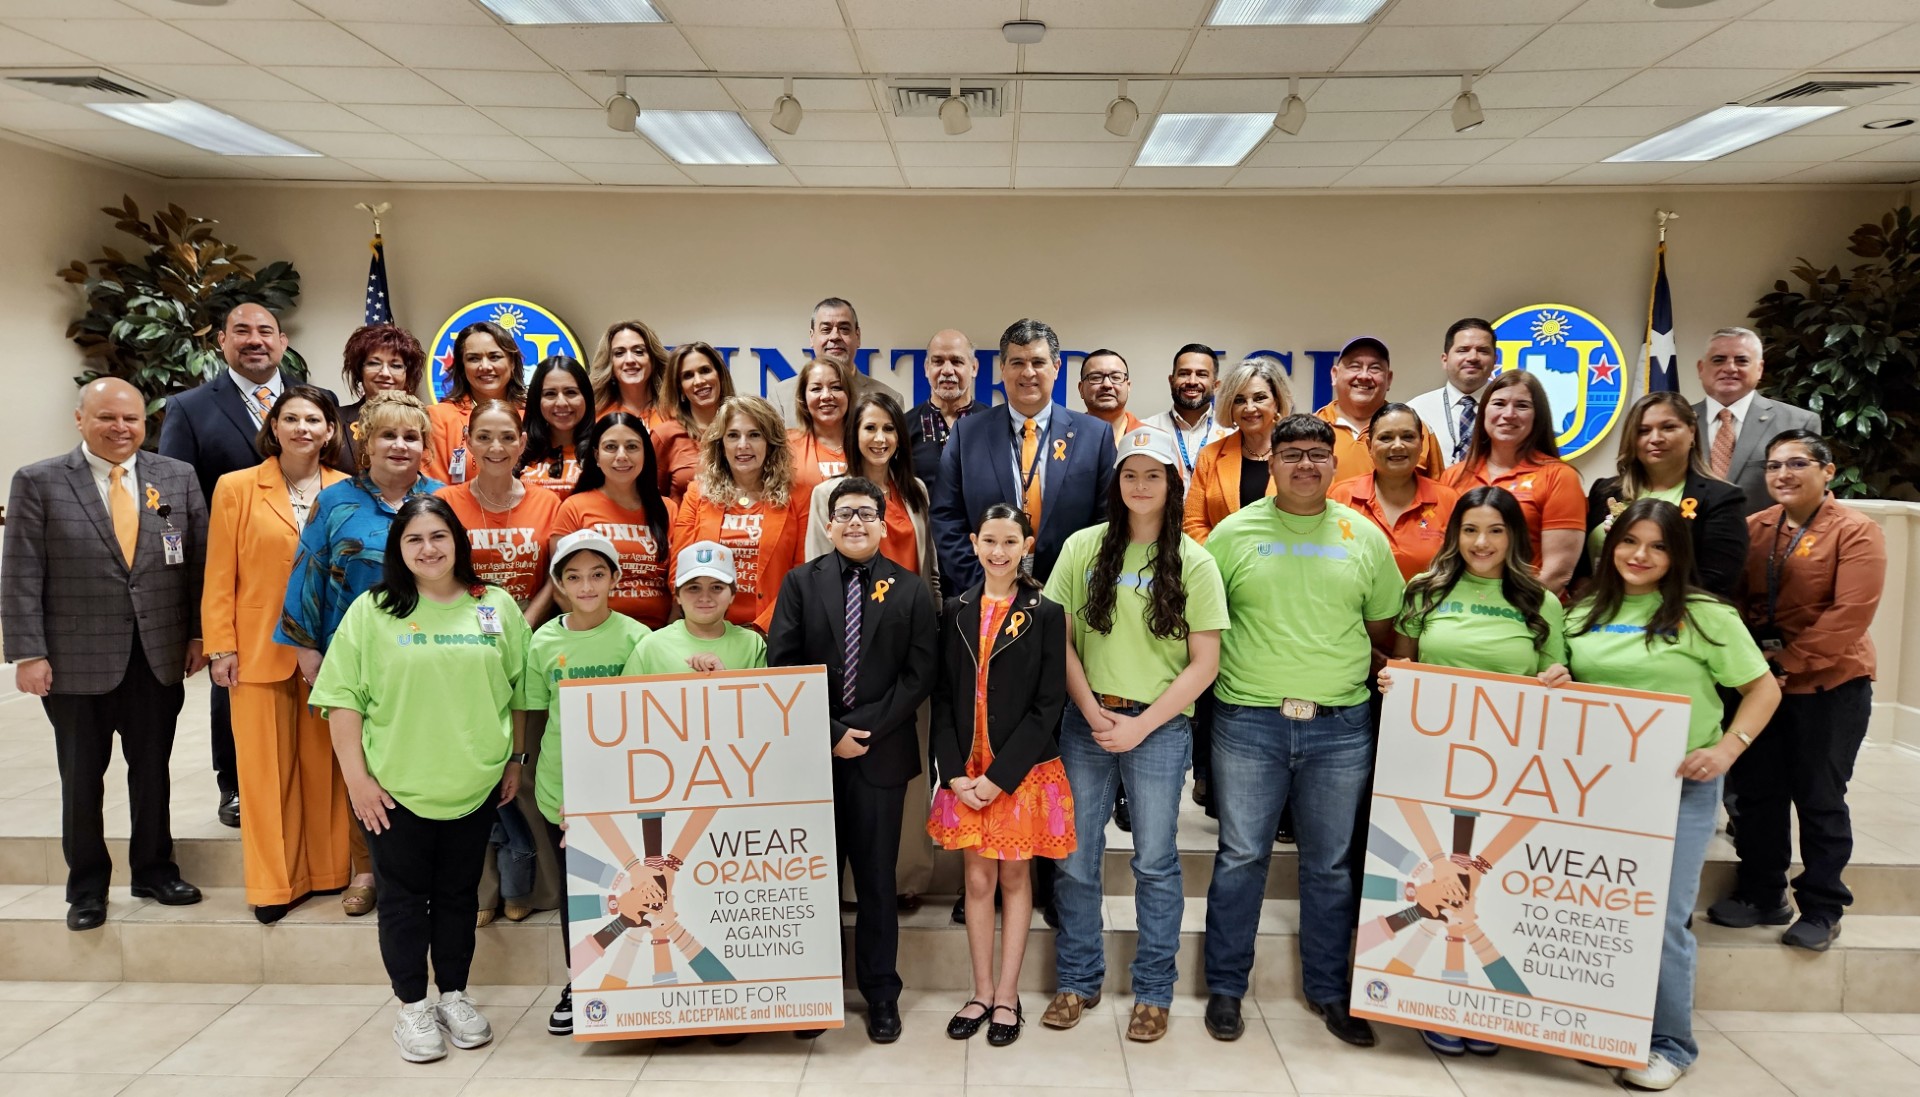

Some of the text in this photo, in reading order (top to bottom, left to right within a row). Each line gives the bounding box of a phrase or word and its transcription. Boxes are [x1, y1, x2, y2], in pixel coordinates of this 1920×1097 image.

[466, 528, 535, 549] NITY
[696, 549, 713, 563] U
[586, 680, 806, 748] UNITY
[1410, 677, 1664, 763] UNITY
[627, 741, 772, 804] DAY
[1444, 742, 1613, 818] DAY
[709, 828, 808, 858] WEAR
[693, 855, 829, 886] ORANGE
[1524, 843, 1638, 887] WEAR
[714, 886, 809, 905] TO CREATE
[1502, 870, 1657, 916] ORANGE
[710, 904, 815, 924] AWARENESS
[1521, 903, 1630, 934] TO CREATE
[725, 923, 802, 941] AGAINST
[1512, 921, 1634, 954] AWARENESS
[724, 941, 805, 959] BULLYING
[1527, 942, 1615, 969] AGAINST
[1523, 958, 1615, 988] BULLYING
[661, 986, 787, 1008] UNITED FOR
[1448, 988, 1588, 1030] UNITED FOR
[679, 1005, 748, 1024] ACCEPTANCE
[750, 1005, 771, 1020] and
[774, 1002, 833, 1018] INCLUSION
[1463, 1012, 1539, 1038] ACCEPTANCE
[1543, 1030, 1566, 1043] and
[1570, 1033, 1638, 1057] INCLUSION
